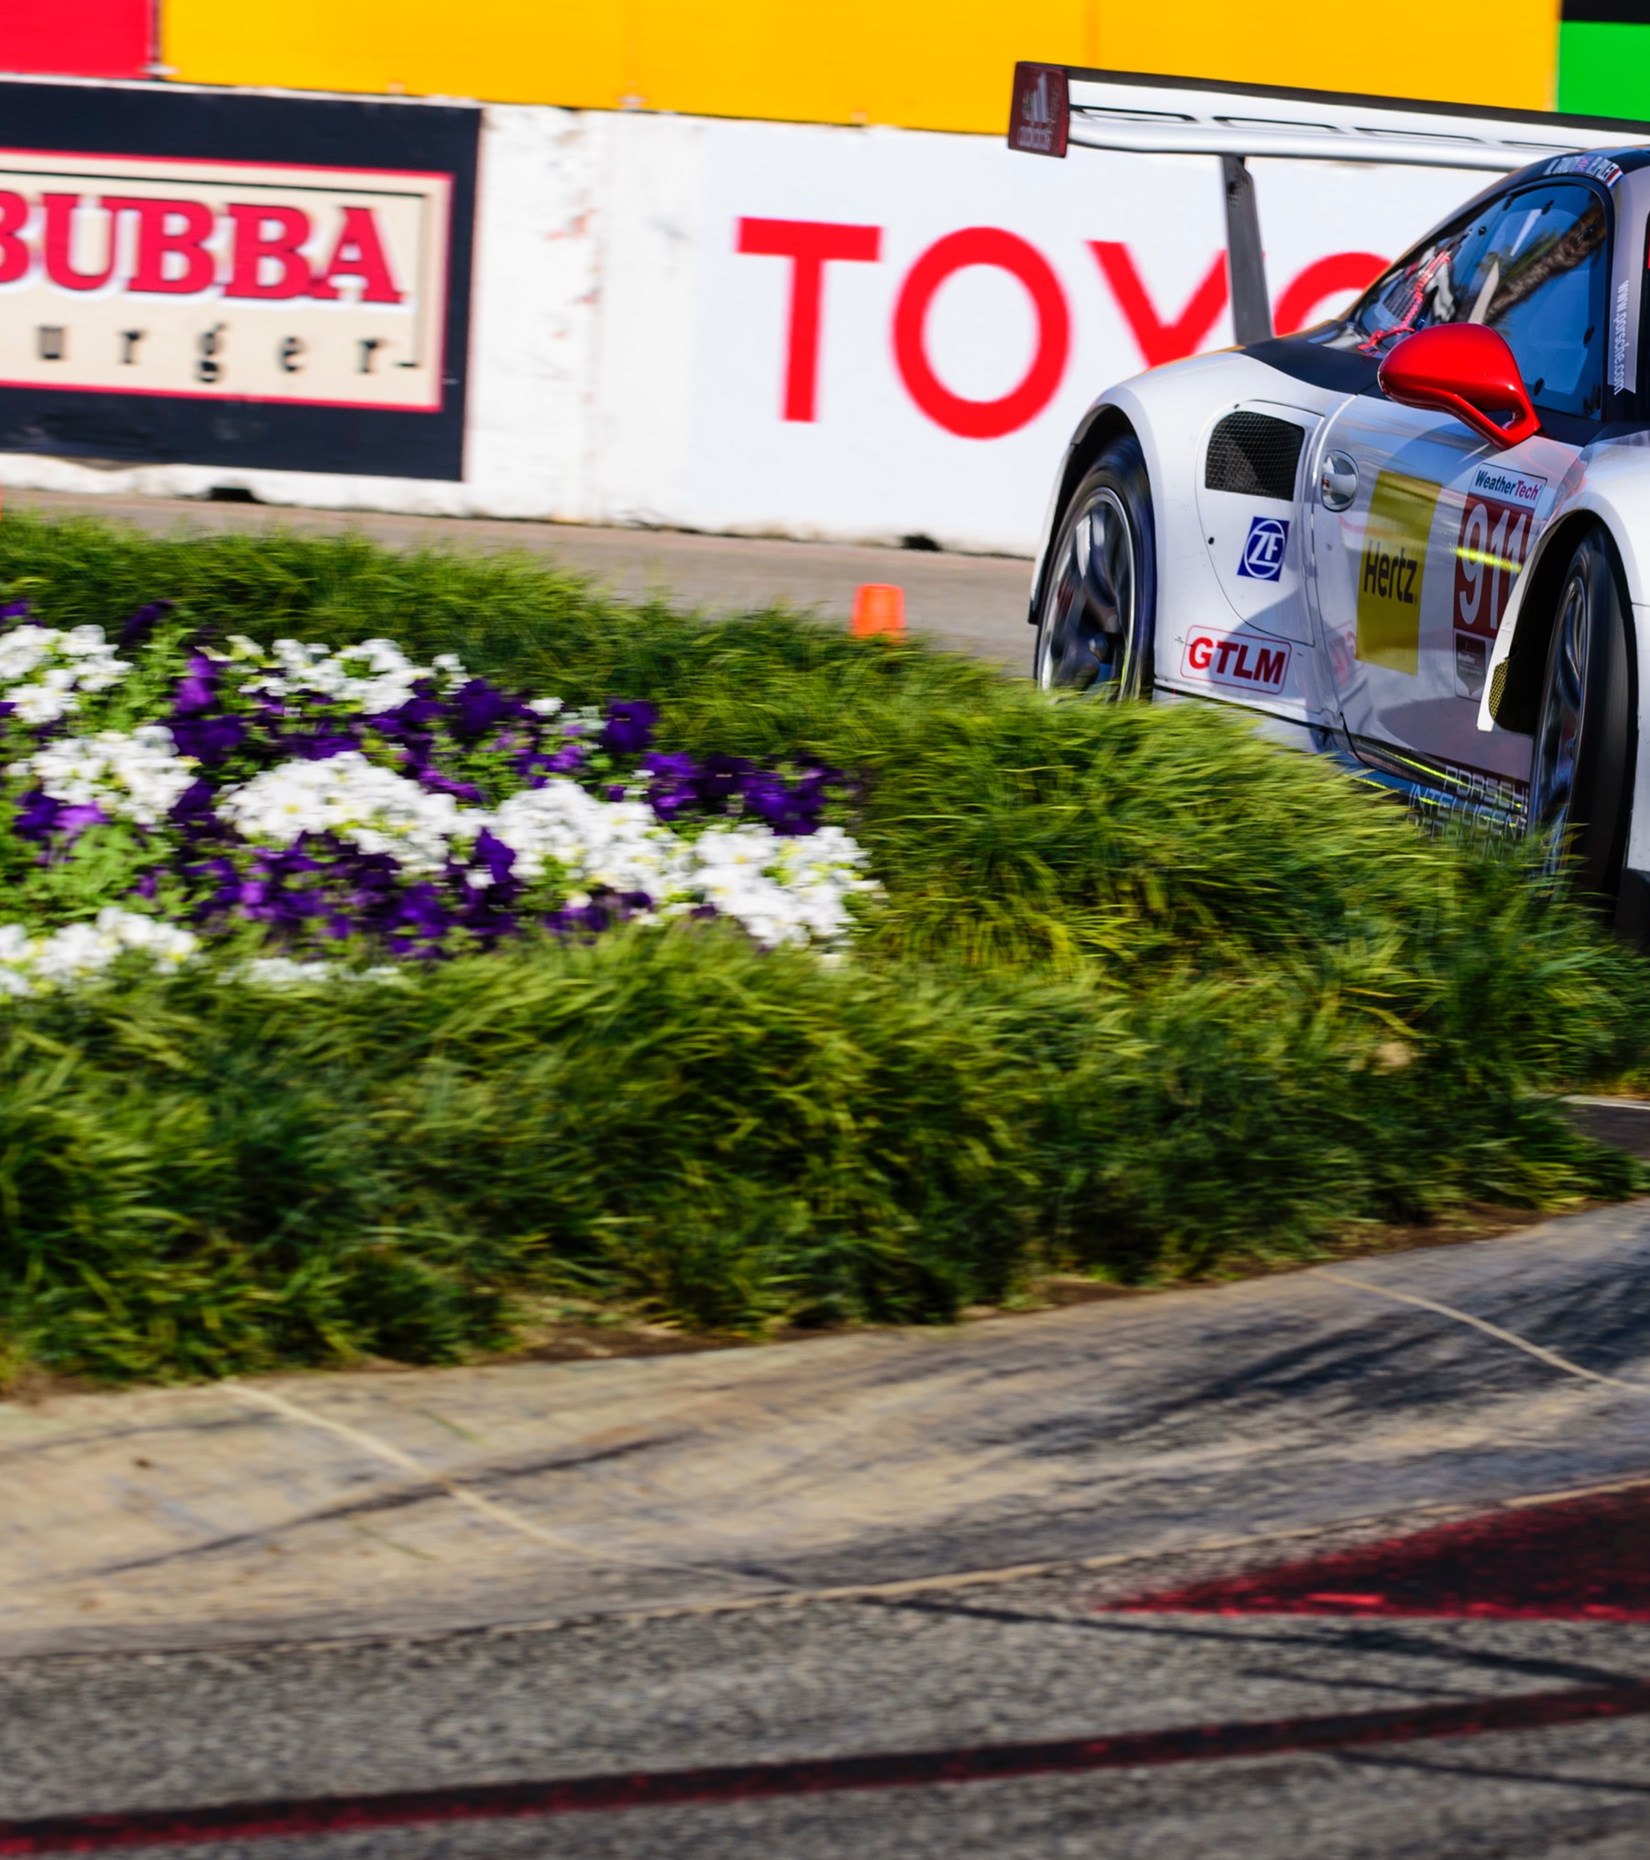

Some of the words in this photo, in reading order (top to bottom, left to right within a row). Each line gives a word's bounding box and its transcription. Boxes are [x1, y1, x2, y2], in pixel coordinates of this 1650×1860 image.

[1613, 279, 1630, 396] www.porsche.com
[1474, 469, 1540, 501] WeatherTech
[1246, 529, 1286, 569] ZF
[1363, 538, 1419, 605] Hertz
[1458, 502, 1528, 631] 911
[1188, 636, 1286, 685] GTLM
